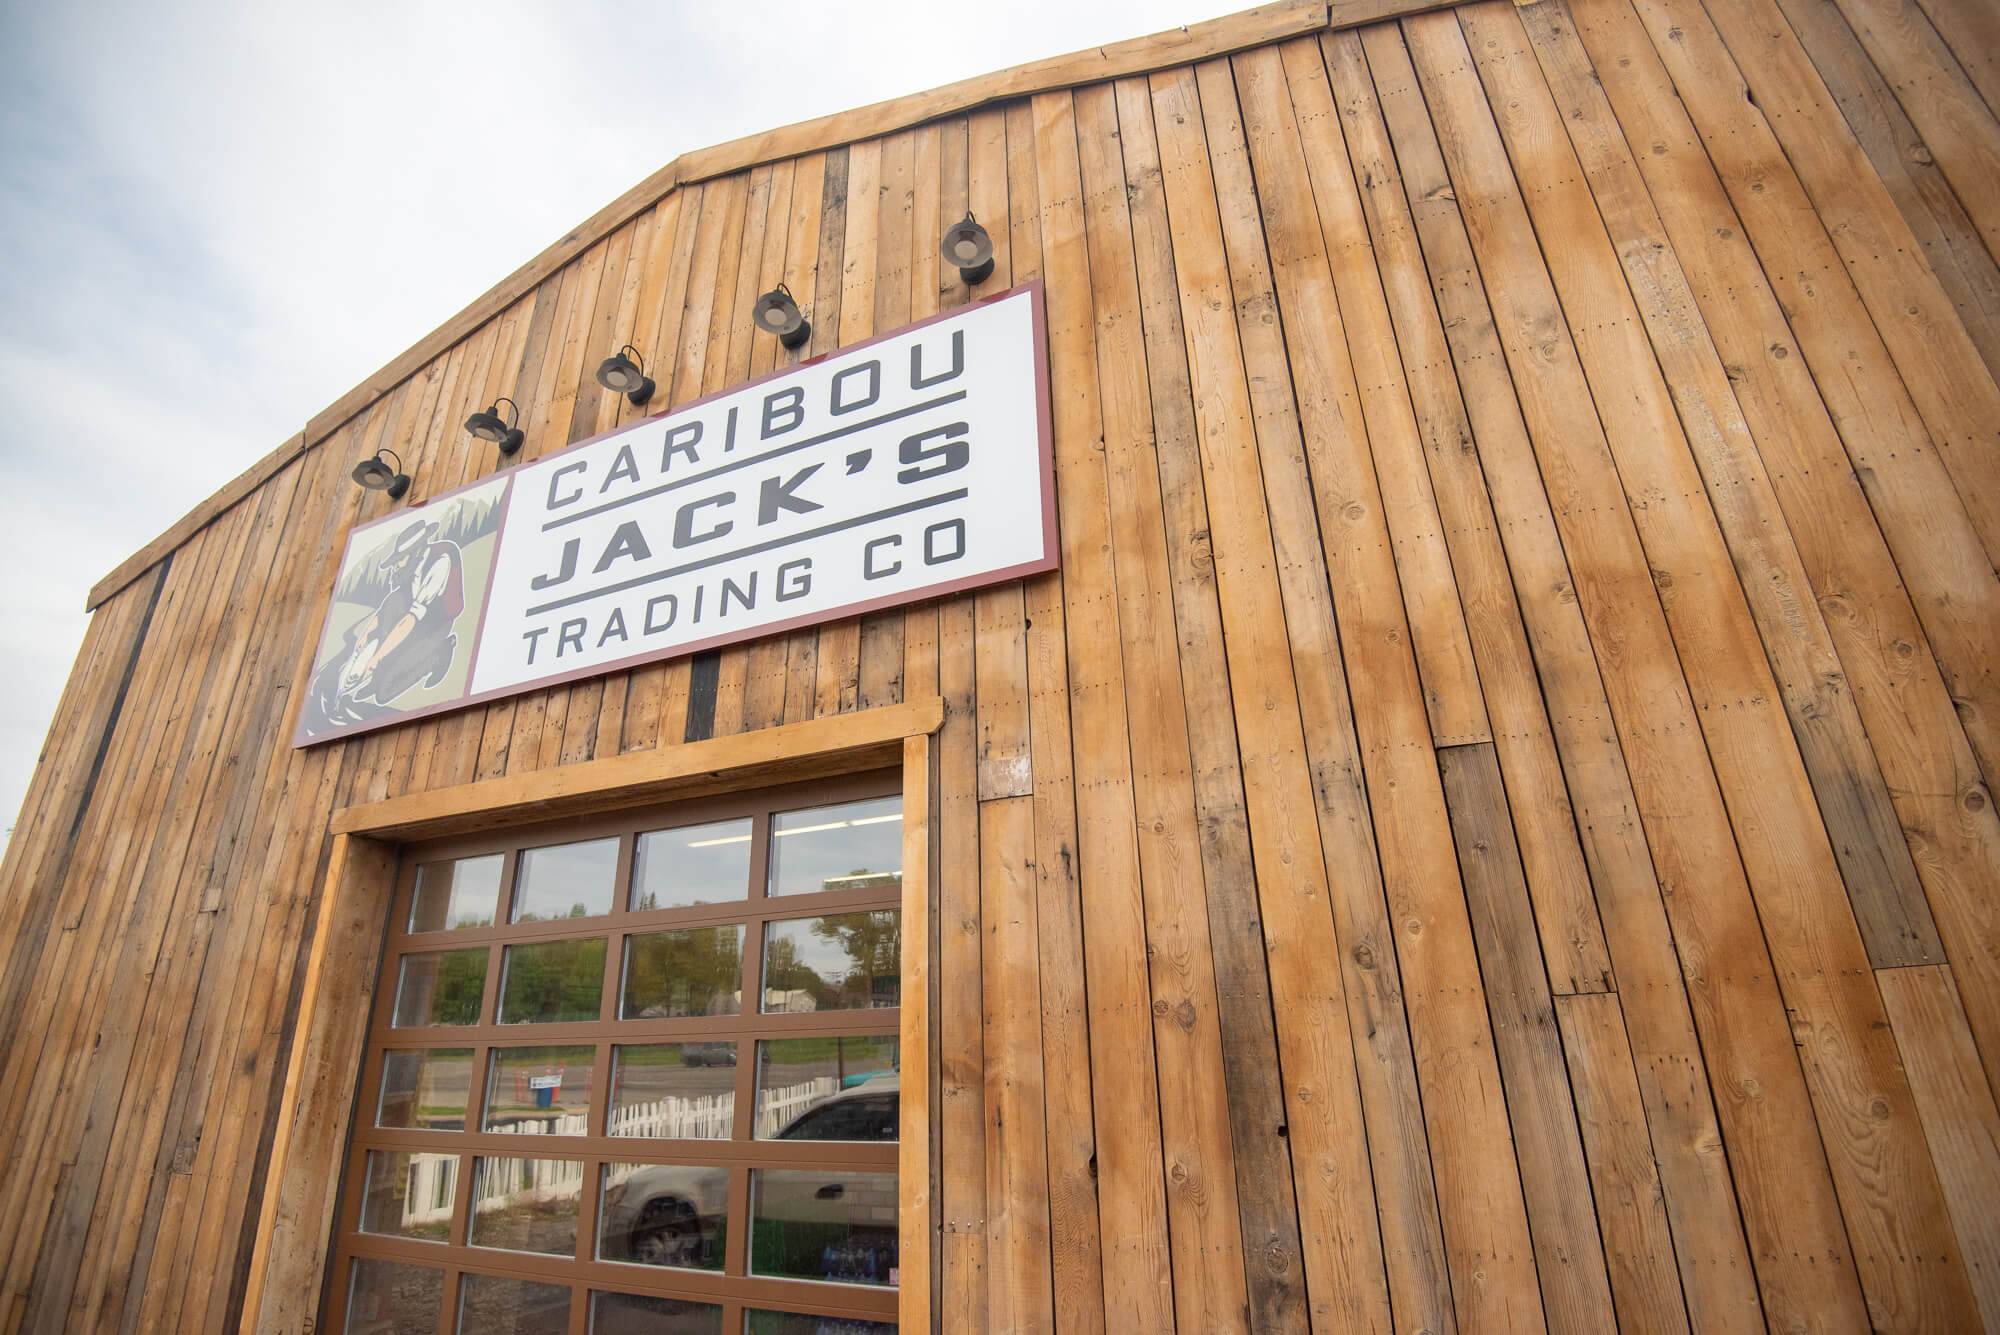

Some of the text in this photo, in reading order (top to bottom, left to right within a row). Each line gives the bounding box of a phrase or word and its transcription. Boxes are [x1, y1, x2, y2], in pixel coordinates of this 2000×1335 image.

[546, 329, 965, 511] CARIBOU
[530, 421, 970, 591] JACK'S
[522, 517, 966, 666] TRADING CO
